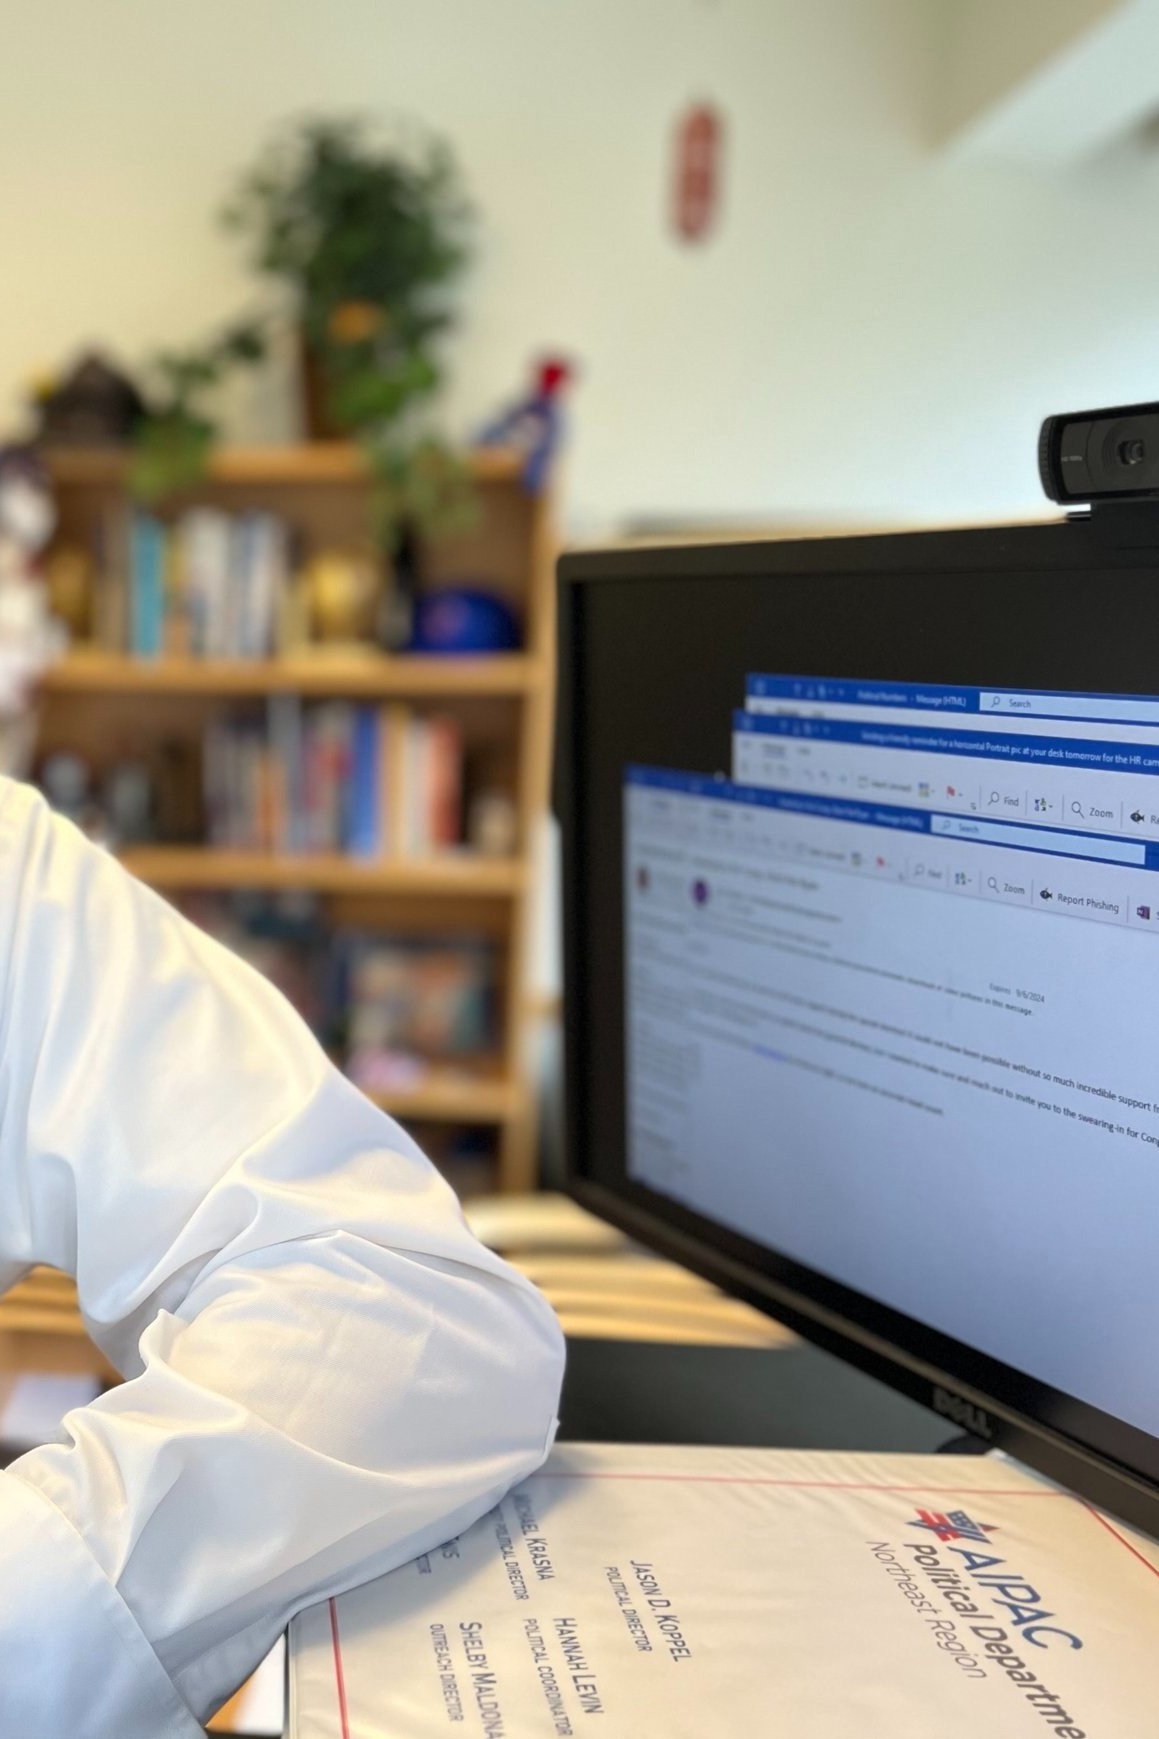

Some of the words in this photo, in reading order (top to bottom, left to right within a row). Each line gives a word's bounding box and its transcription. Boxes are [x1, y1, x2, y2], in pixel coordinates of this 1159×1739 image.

[1009, 698, 1032, 709] Search
[986, 742, 1010, 753] Portrait
[1011, 746, 1021, 756] pic
[1023, 747, 1030, 755] at
[1030, 749, 1047, 759] your
[1048, 748, 1064, 758] desk
[1065, 751, 1101, 762] tomorrow
[1102, 753, 1114, 763] for
[1115, 754, 1129, 764] the
[1130, 755, 1141, 765] HR
[1004, 796, 1019, 808] Find
[1089, 808, 1114, 819] Zoom
[959, 823, 979, 834] Search
[1004, 884, 1025, 895] Zoom
[1057, 894, 1084, 906] Report
[1086, 898, 1119, 914] Phishing
[1016, 989, 1045, 1003] 9/6/2024
[1012, 1063, 1041, 1078] without
[1043, 1072, 1051, 1081] so
[1053, 1076, 1075, 1089] much
[1076, 1081, 1117, 1101] incredible
[1118, 1095, 1152, 1112] support
[1005, 1089, 1014, 1098] to
[1015, 1092, 1036, 1105] invite
[1037, 1101, 1052, 1112] you
[1053, 1104, 1062, 1114] to
[1063, 1107, 1077, 1119] the
[1078, 1113, 1125, 1134] swearing-in
[1126, 1126, 1139, 1139] for
[495, 1523, 511, 1561] POLITICAL
[505, 1560, 529, 1601] DIRECTOR
[525, 1537, 555, 1582] KRASNA
[630, 1560, 662, 1596] JASON
[605, 1566, 632, 1607] POLITICAL
[622, 1608, 652, 1652] DIRECTOR
[648, 1599, 671, 1612] D.
[866, 1541, 940, 1615] Northeast
[925, 1618, 987, 1679] Region
[947, 1546, 1083, 1650] AIPAC
[430, 1623, 453, 1672] OUTREACH
[459, 1621, 489, 1671] SHELBY
[654, 1614, 692, 1663] KOPPEL
[904, 1544, 994, 1620] Political
[969, 1625, 1086, 1739] Departme
[523, 1618, 550, 1664] POLITICAL
[537, 1665, 573, 1737] COORDINATOR
[553, 1617, 589, 1671] HANNAH
[572, 1675, 605, 1714] LEVIN
[440, 1673, 464, 1722] DIRECTOR
